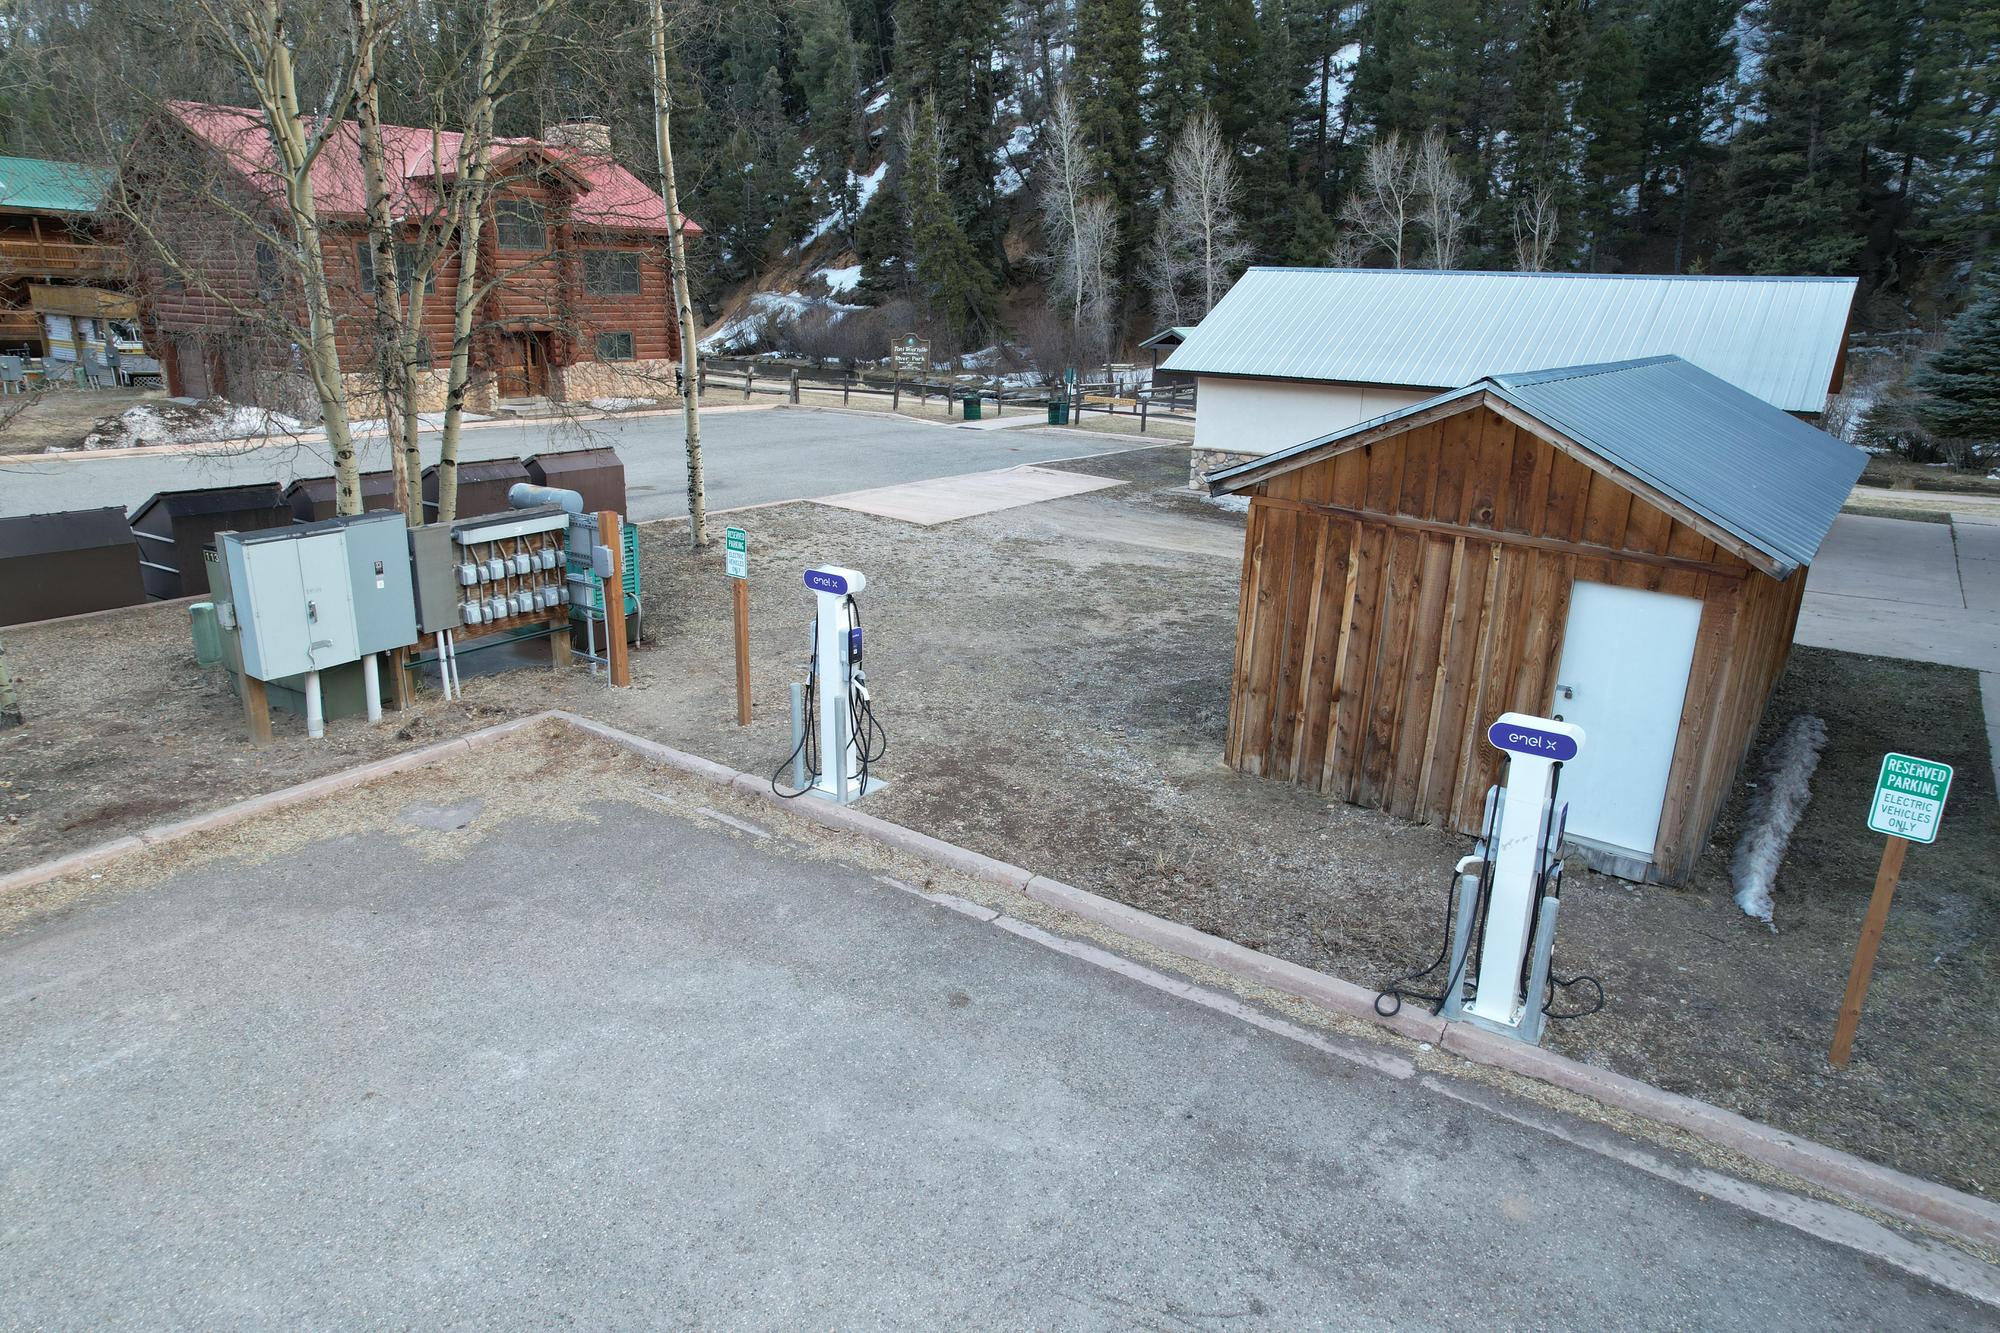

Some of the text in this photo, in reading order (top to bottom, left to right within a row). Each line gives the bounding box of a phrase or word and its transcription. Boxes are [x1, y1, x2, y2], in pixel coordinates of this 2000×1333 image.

[728, 530, 745, 541] RESERVED
[728, 539, 745, 550] PARKING
[813, 576, 831, 587] enel
[1508, 733, 1542, 748] enel
[1887, 758, 1947, 782] RESERVED
[1887, 774, 1940, 796] PARKING
[1884, 793, 1933, 812] ELECTRIC
[1881, 804, 1931, 824] VEHICLES
[1888, 818, 1917, 831] ONLY
